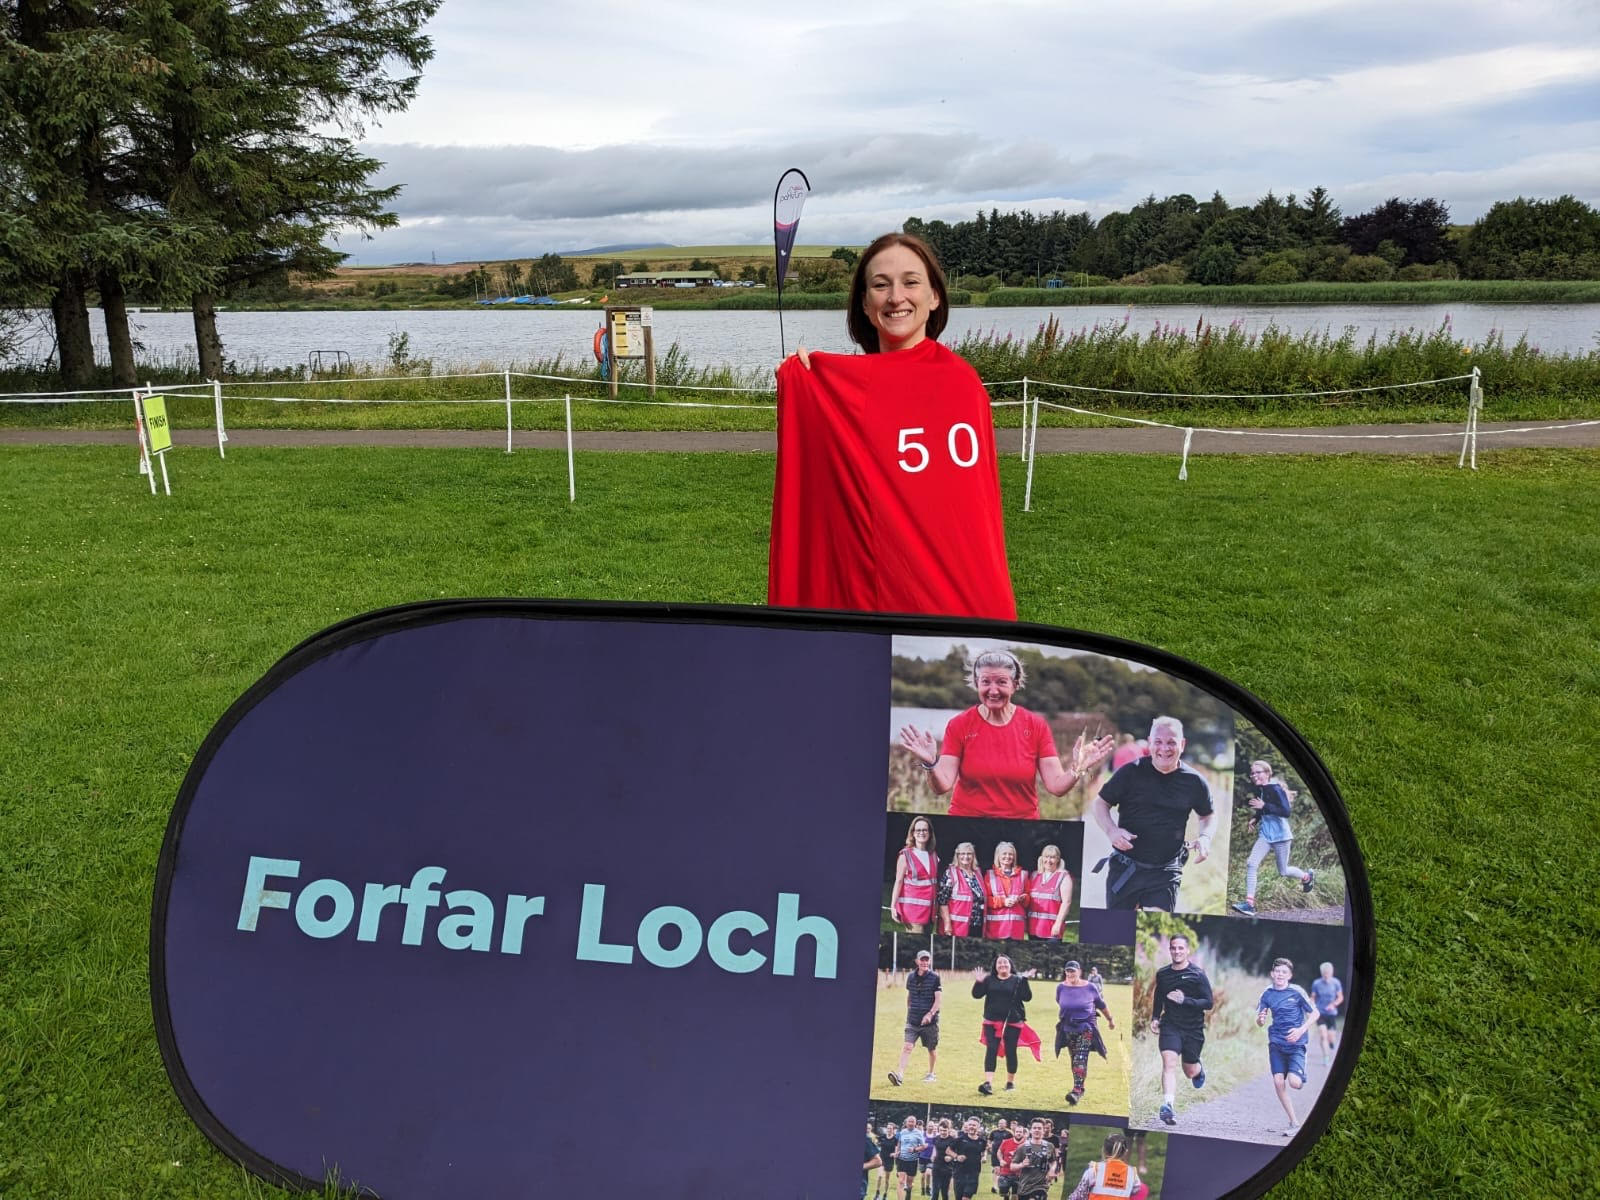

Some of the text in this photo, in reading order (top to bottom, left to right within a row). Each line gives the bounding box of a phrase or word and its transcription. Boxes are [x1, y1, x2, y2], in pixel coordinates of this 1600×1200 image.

[149, 415, 167, 430] FINISH
[237, 856, 838, 979] Forfar Loch
